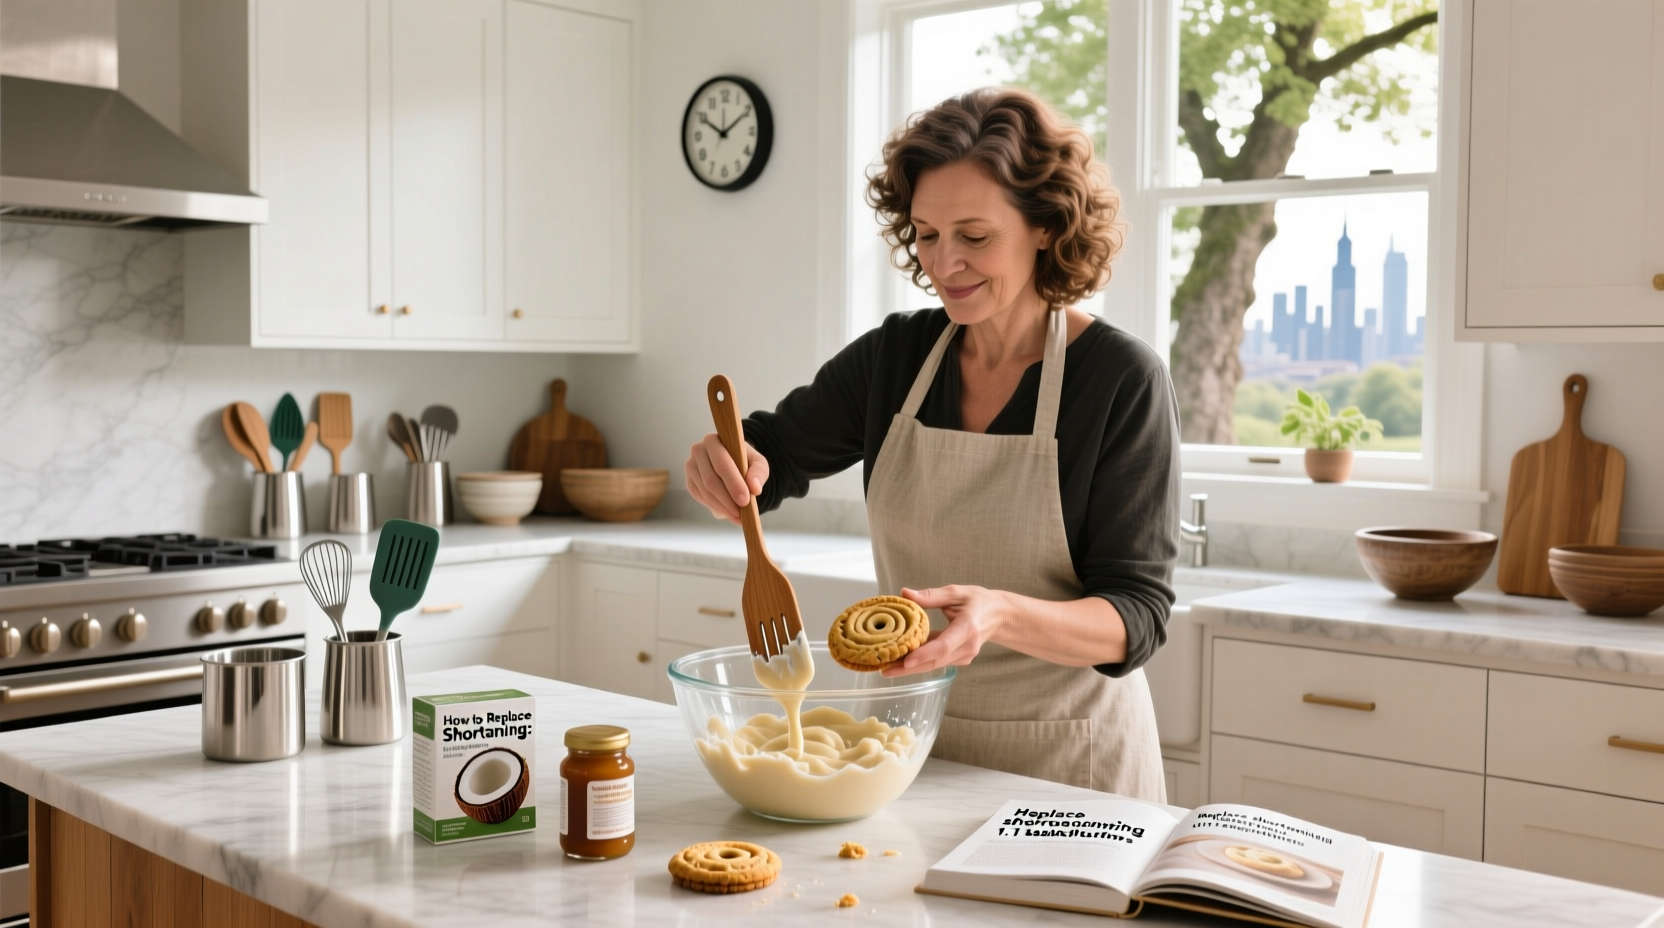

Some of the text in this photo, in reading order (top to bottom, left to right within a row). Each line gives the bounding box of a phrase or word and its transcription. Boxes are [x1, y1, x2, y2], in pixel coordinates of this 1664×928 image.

[720, 88, 730, 103] 12
[443, 714, 470, 726] How
[472, 713, 484, 725] to
[487, 710, 532, 725] Replace
